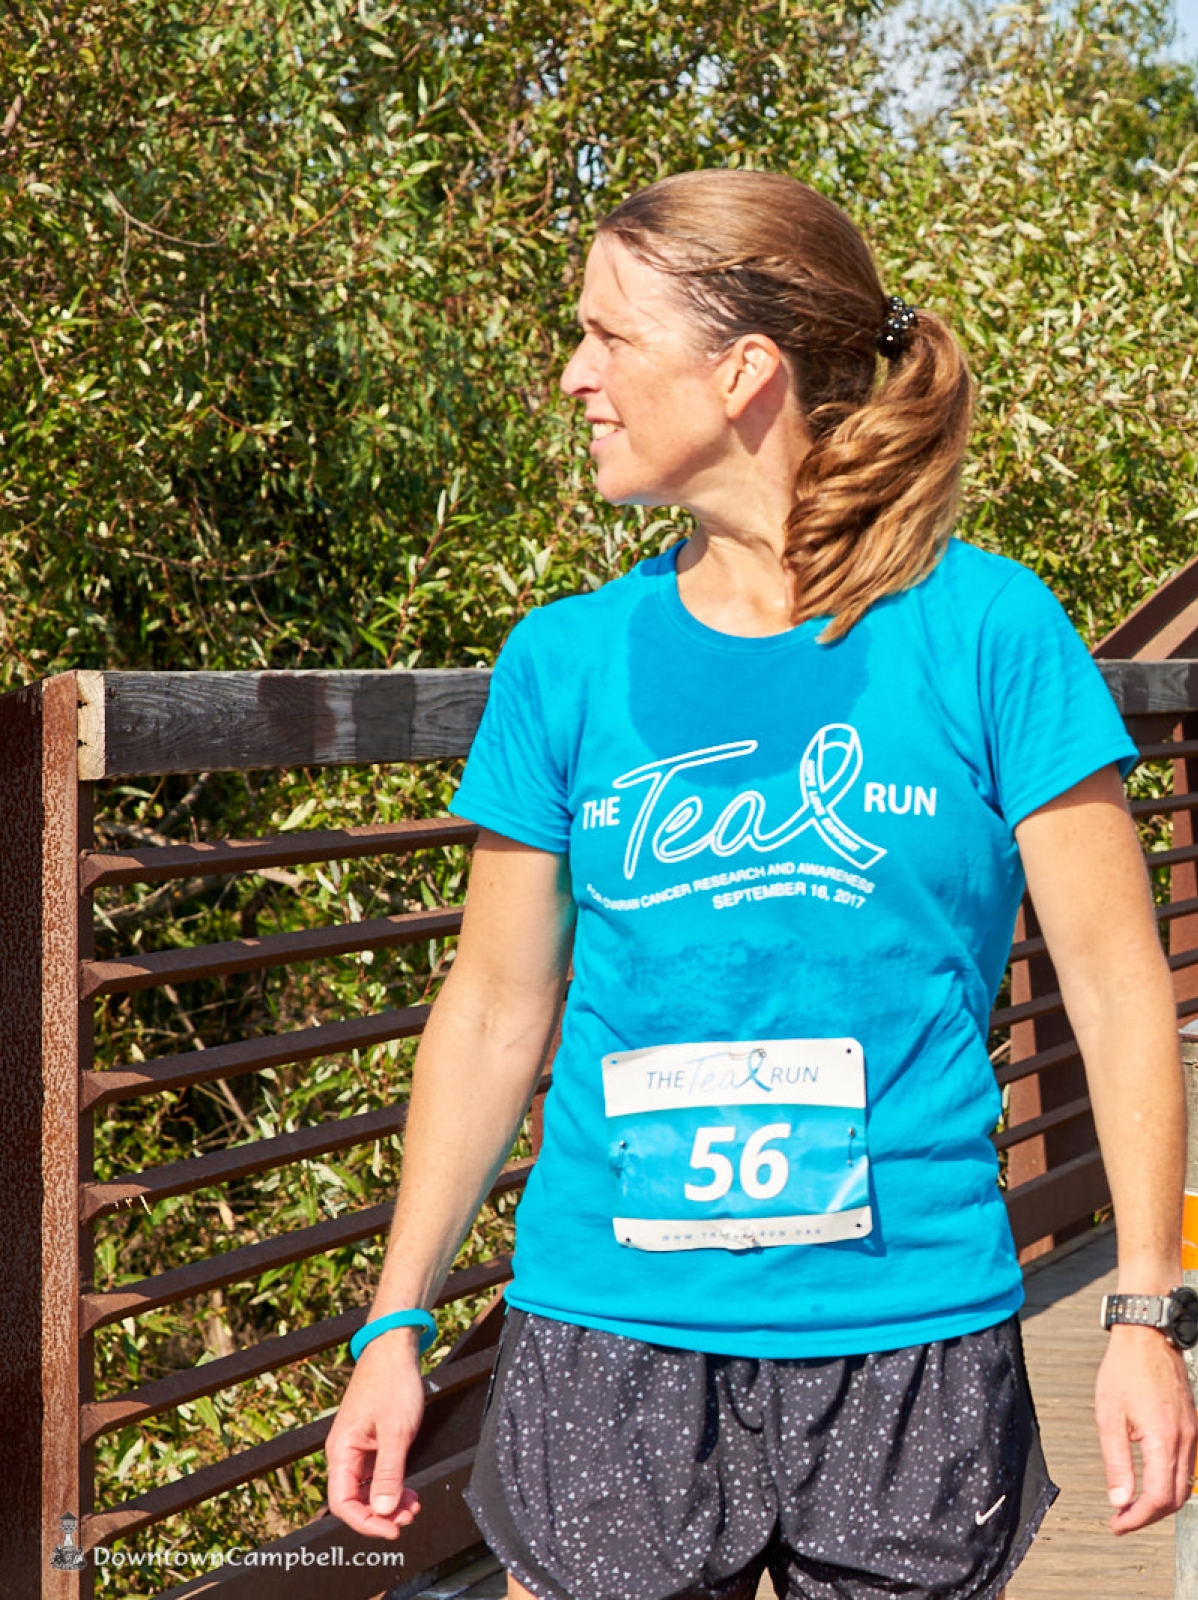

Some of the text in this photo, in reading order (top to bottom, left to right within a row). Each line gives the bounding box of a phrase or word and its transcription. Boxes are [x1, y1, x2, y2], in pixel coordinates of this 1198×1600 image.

[582, 797, 620, 830] THE
[612, 723, 888, 880] Teal
[863, 782, 937, 816] RUN
[640, 883, 692, 908] CANCER
[692, 866, 767, 892] RESEARCH
[767, 861, 796, 876] AND
[797, 863, 875, 893] AWARENESS
[712, 881, 807, 909] SEPTEMBER
[833, 888, 867, 909] 2017
[646, 1070, 685, 1089] THE
[770, 1066, 820, 1084] RUN
[683, 1122, 792, 1203] 56
